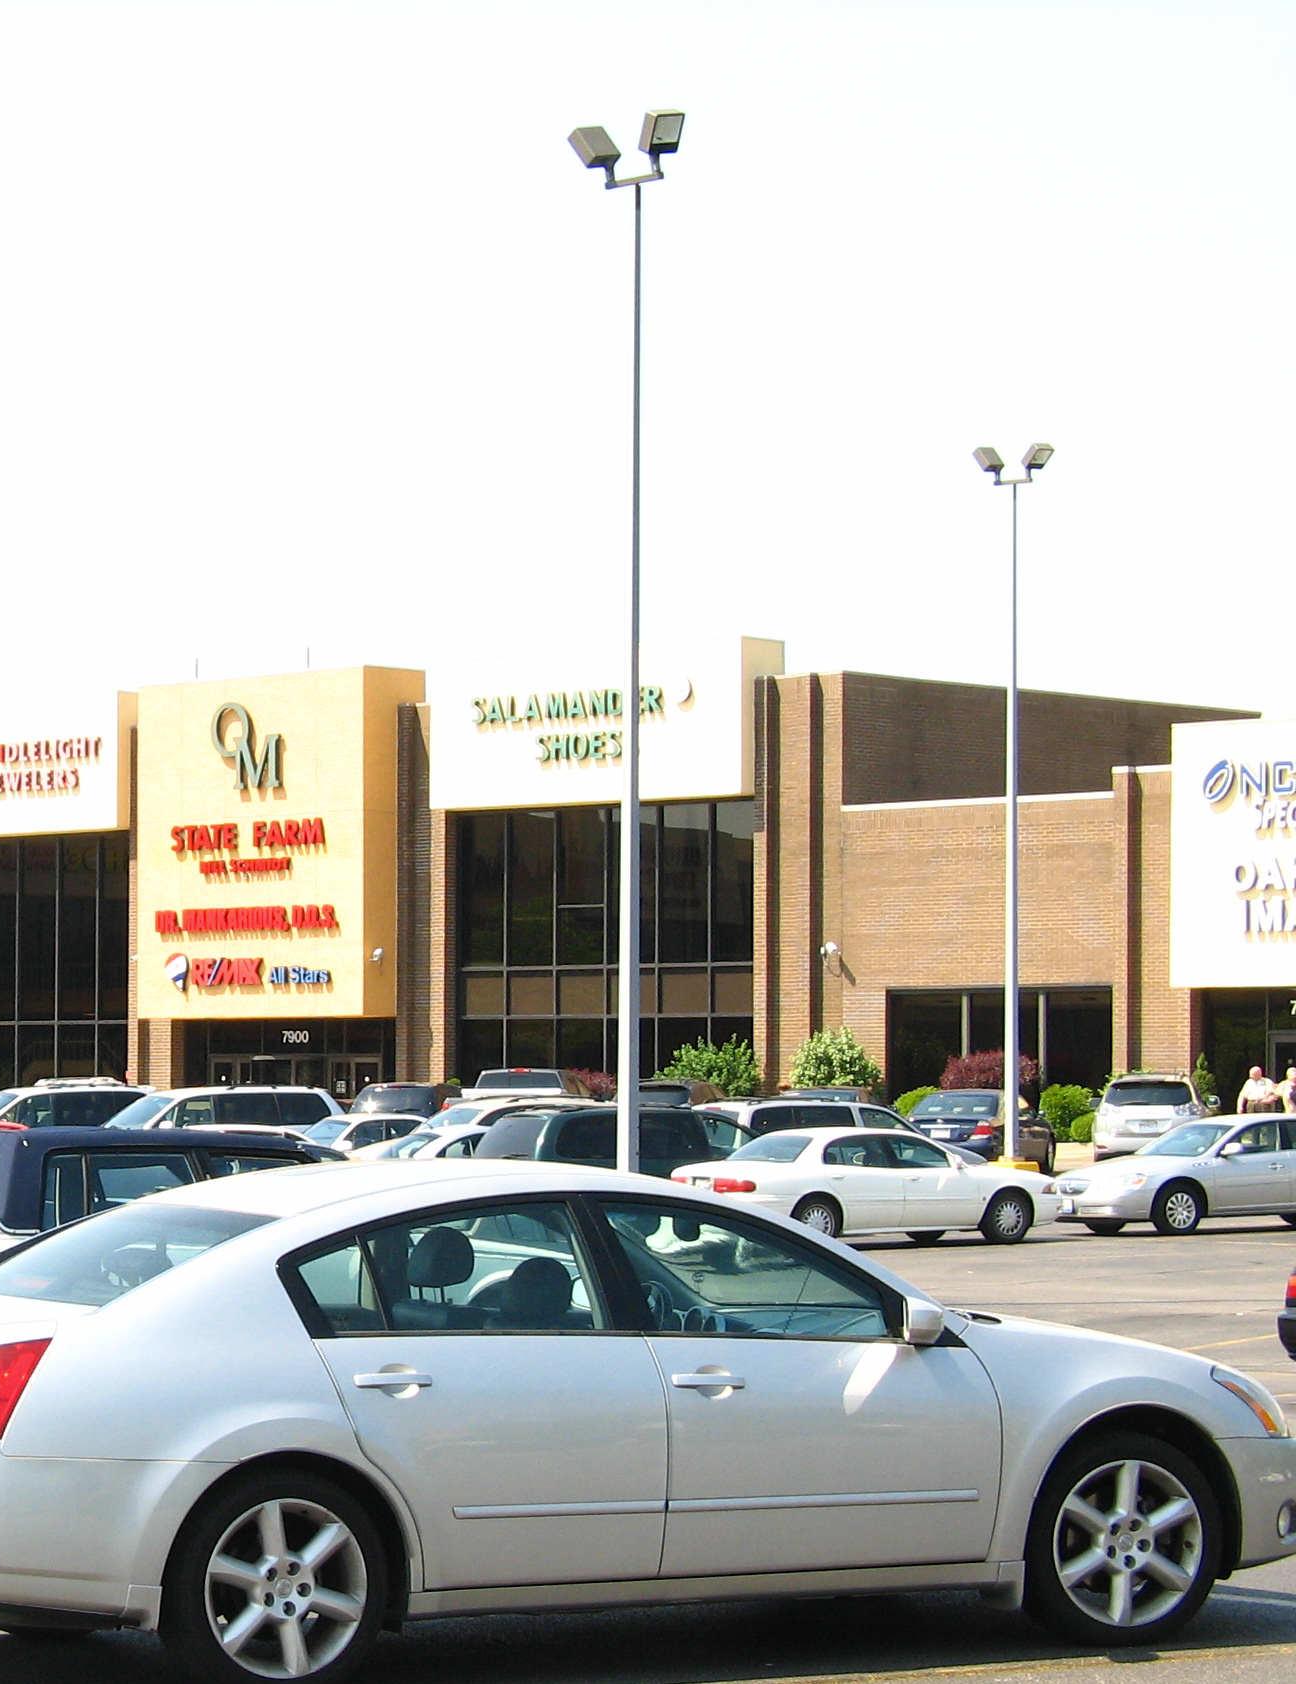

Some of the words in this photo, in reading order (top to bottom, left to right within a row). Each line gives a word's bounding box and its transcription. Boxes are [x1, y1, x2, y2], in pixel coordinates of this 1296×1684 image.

[472, 686, 665, 725] SALAMANDR
[536, 731, 623, 762] SHOES
[171, 823, 239, 851] STATE
[253, 817, 327, 849] FARM
[191, 957, 264, 986] RE/MAX
[269, 966, 289, 984] All
[290, 965, 331, 984] Stars
[281, 1030, 310, 1044] 7900
